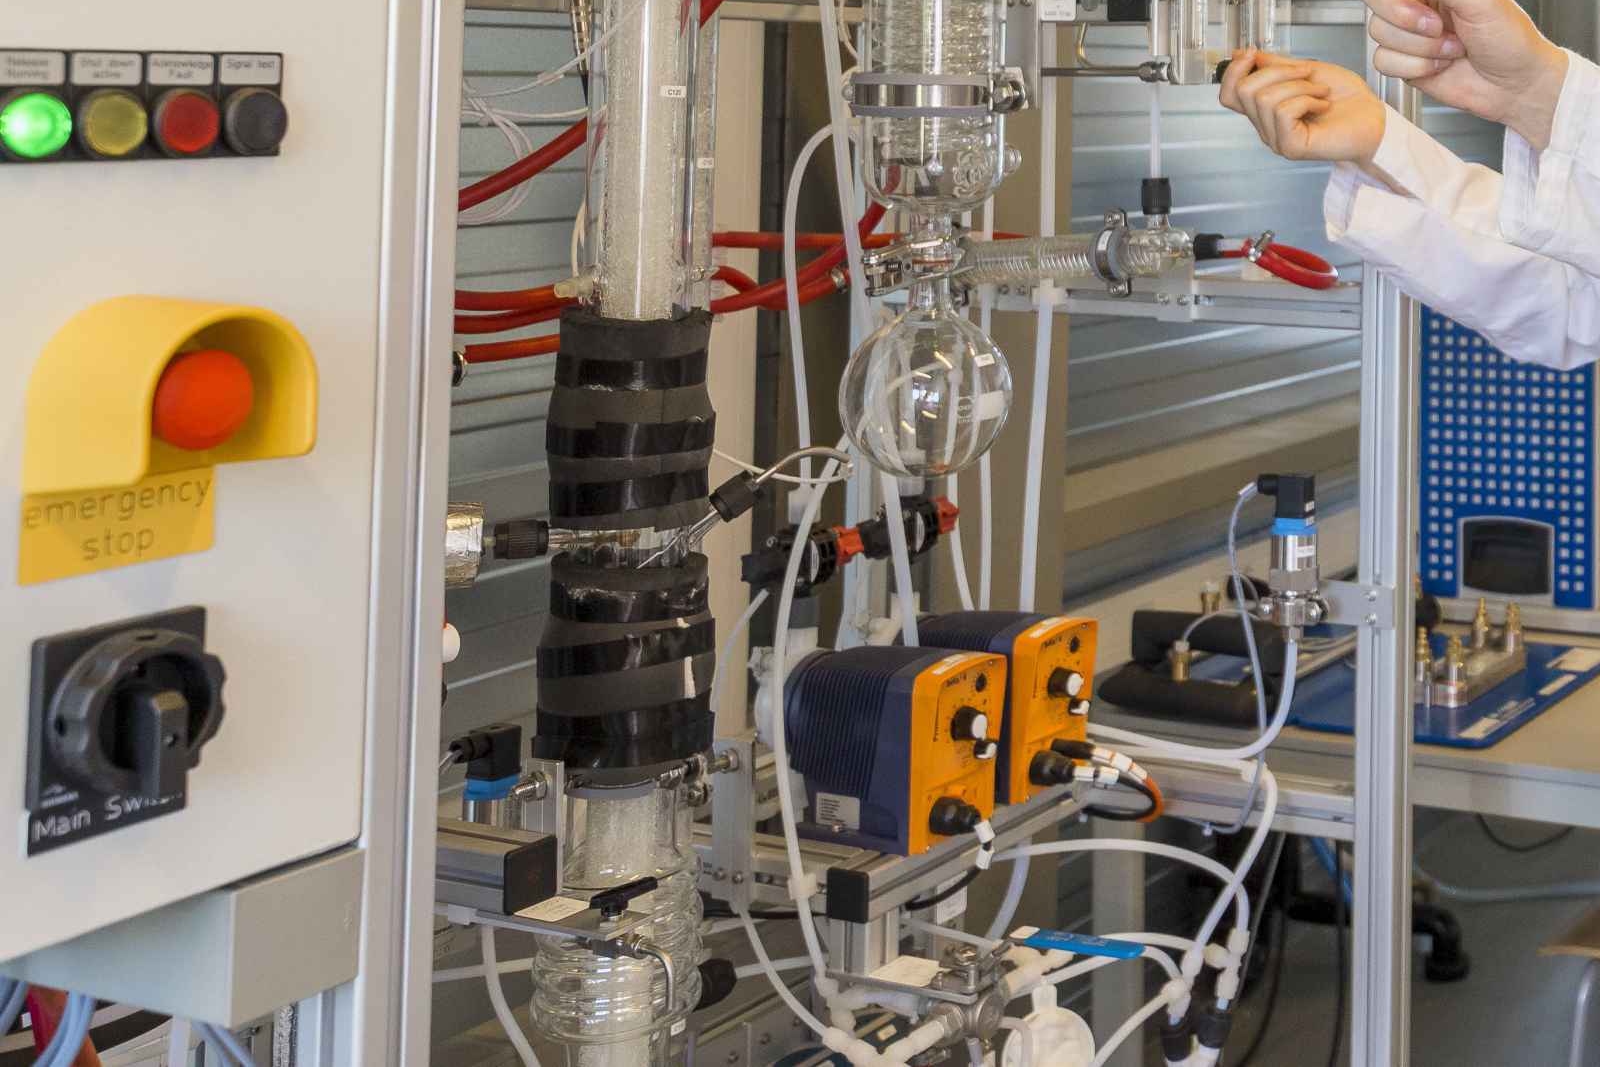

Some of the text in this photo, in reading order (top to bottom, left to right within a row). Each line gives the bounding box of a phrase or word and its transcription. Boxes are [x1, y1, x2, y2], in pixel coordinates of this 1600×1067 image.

[23, 478, 212, 529] emergency
[82, 527, 155, 561] stop
[32, 809, 91, 842] Main
